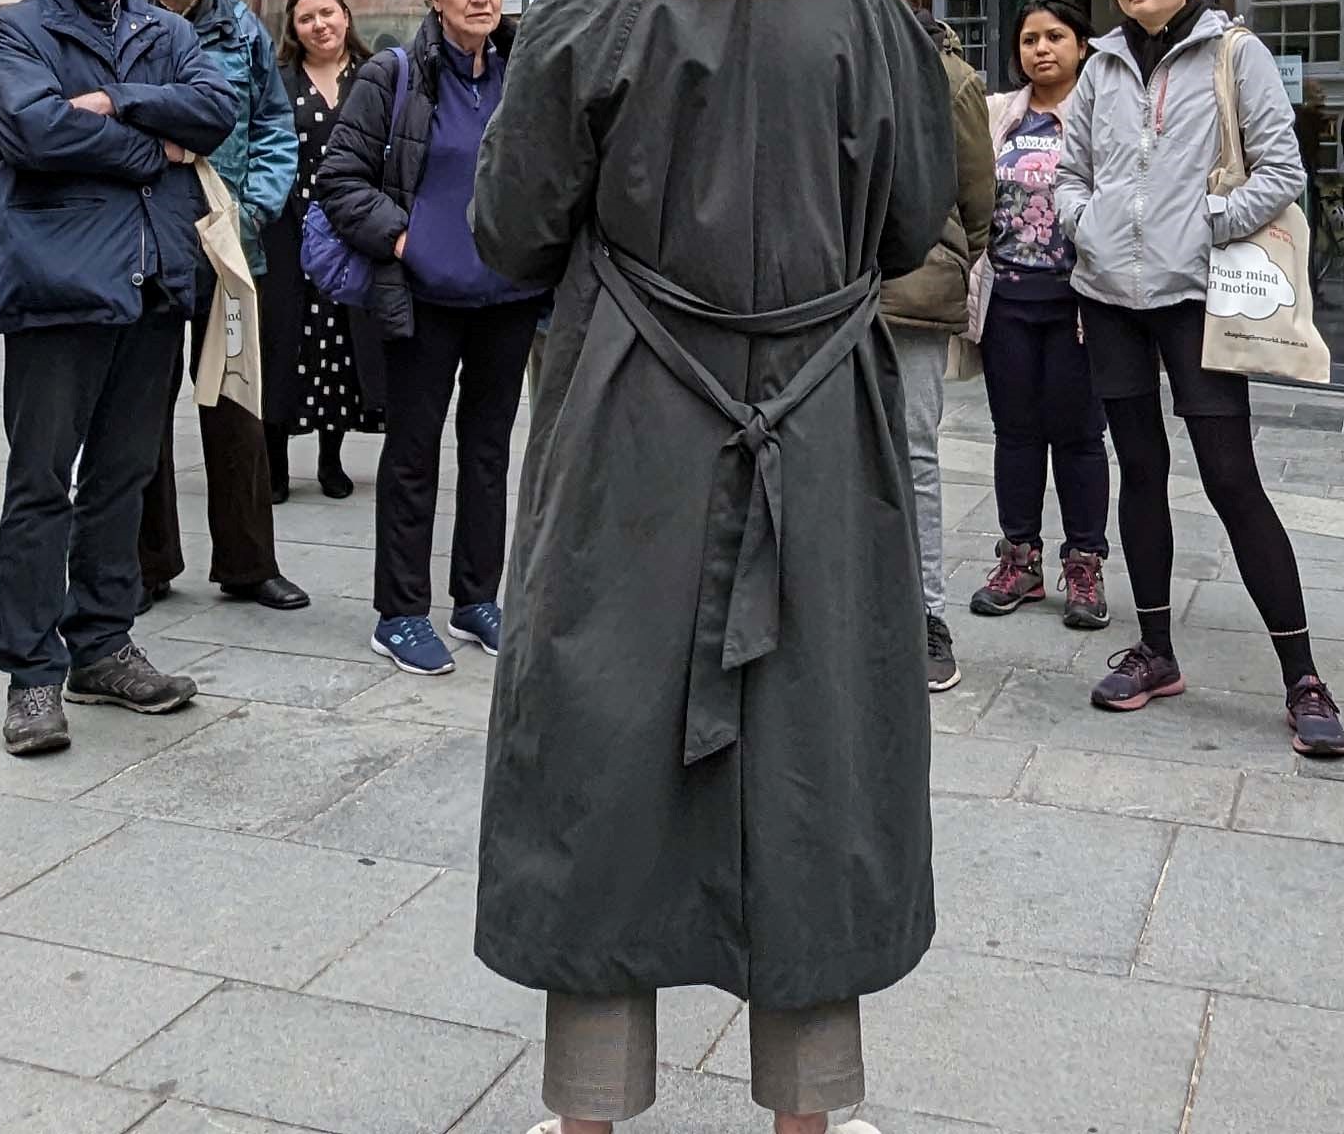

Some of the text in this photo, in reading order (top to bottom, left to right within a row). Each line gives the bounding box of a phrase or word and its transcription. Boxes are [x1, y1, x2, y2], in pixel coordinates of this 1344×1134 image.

[1279, 67, 1295, 77] RY
[1023, 169, 1053, 183] INS
[1246, 269, 1279, 285] mind
[1221, 281, 1267, 297] motion
